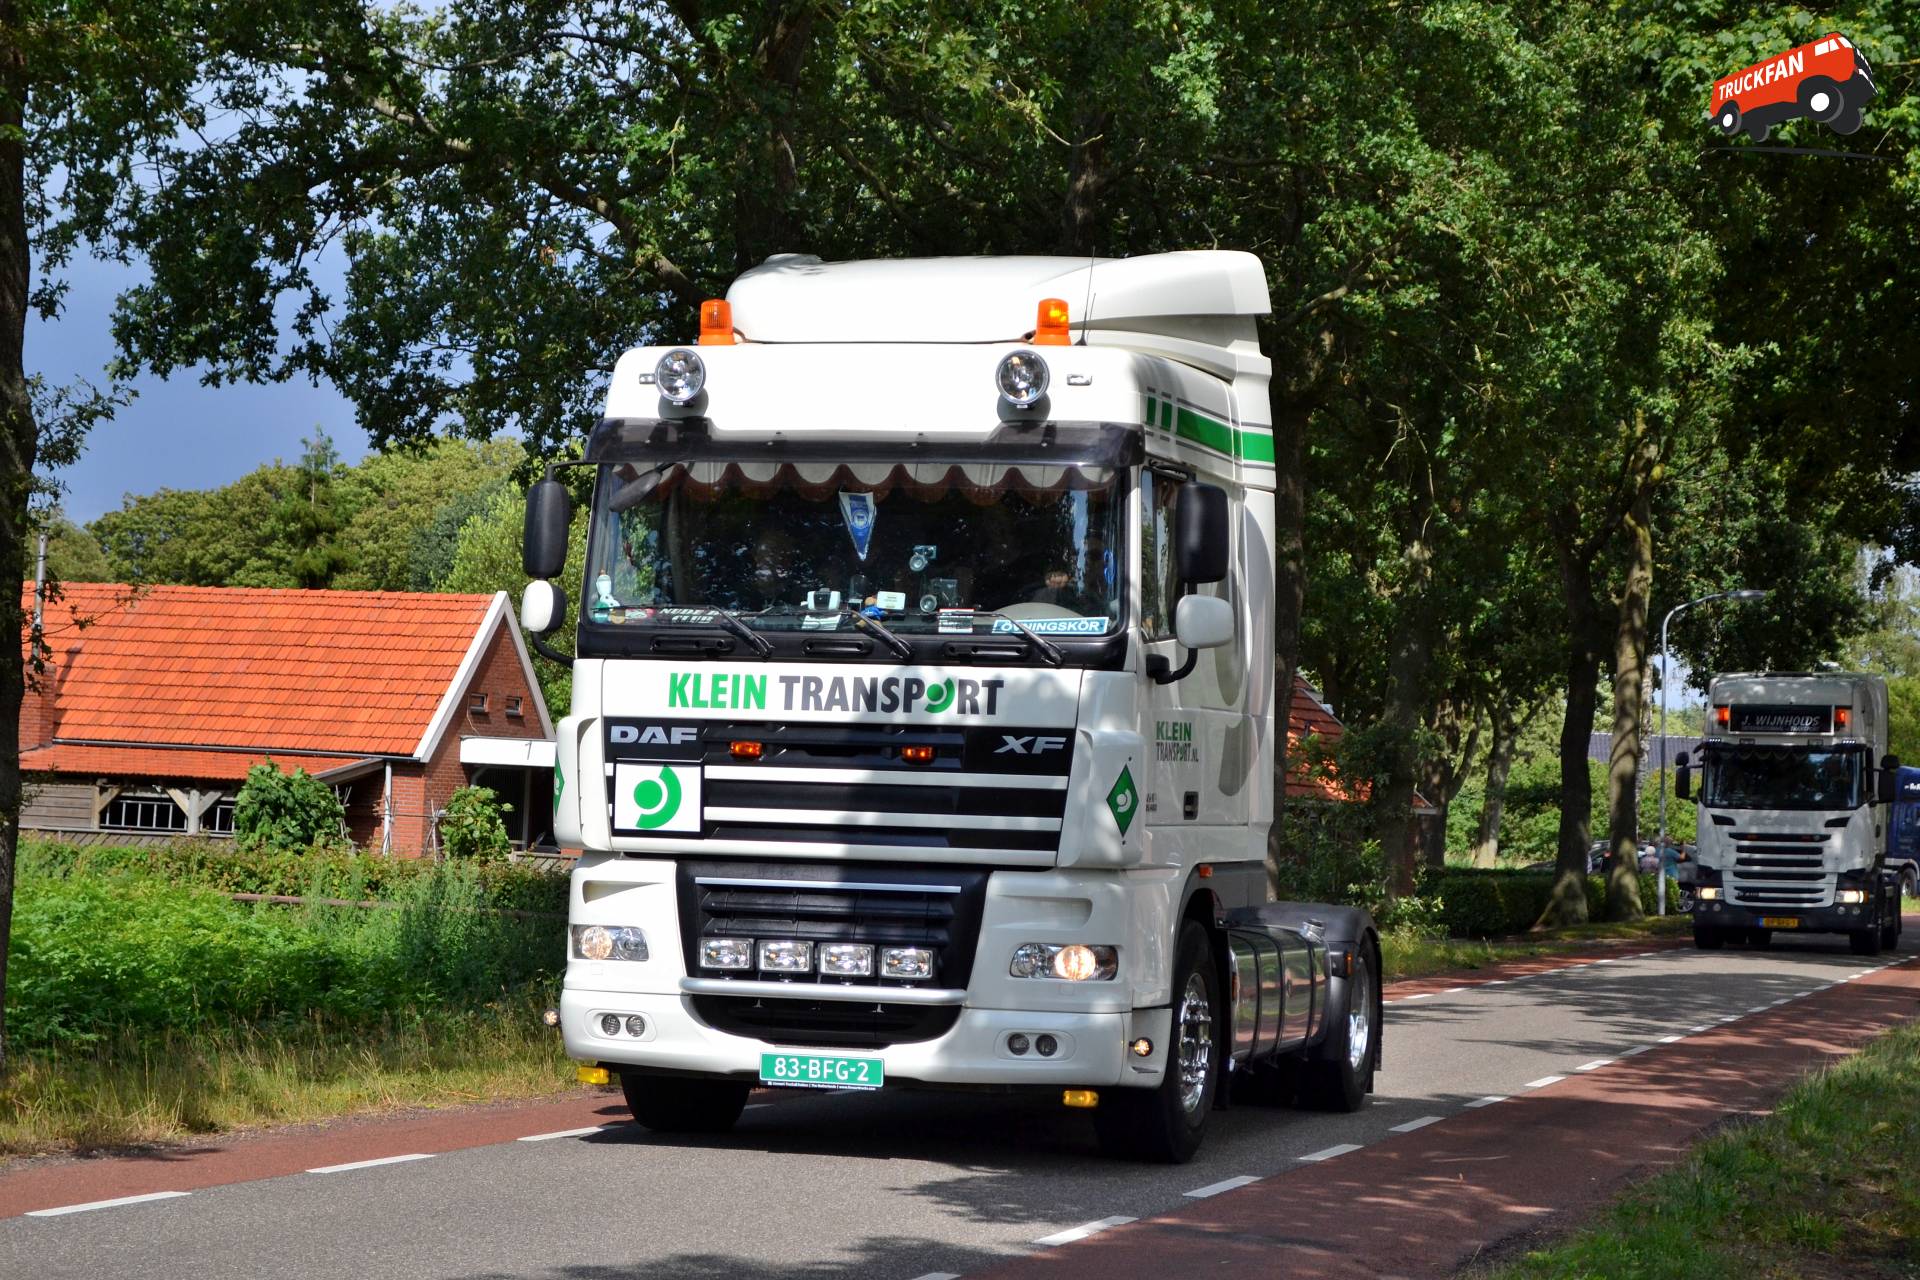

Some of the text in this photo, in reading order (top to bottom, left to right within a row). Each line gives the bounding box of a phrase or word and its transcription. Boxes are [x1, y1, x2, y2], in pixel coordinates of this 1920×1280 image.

[668, 673, 1004, 715] KLEIN TRANSPORT
[1156, 720, 1192, 741] KLEIN
[1756, 715, 1820, 726] WIJNHOLDS
[610, 725, 697, 744] DAF
[994, 735, 1067, 754] XF
[774, 1057, 869, 1082] 83-BFG-2
